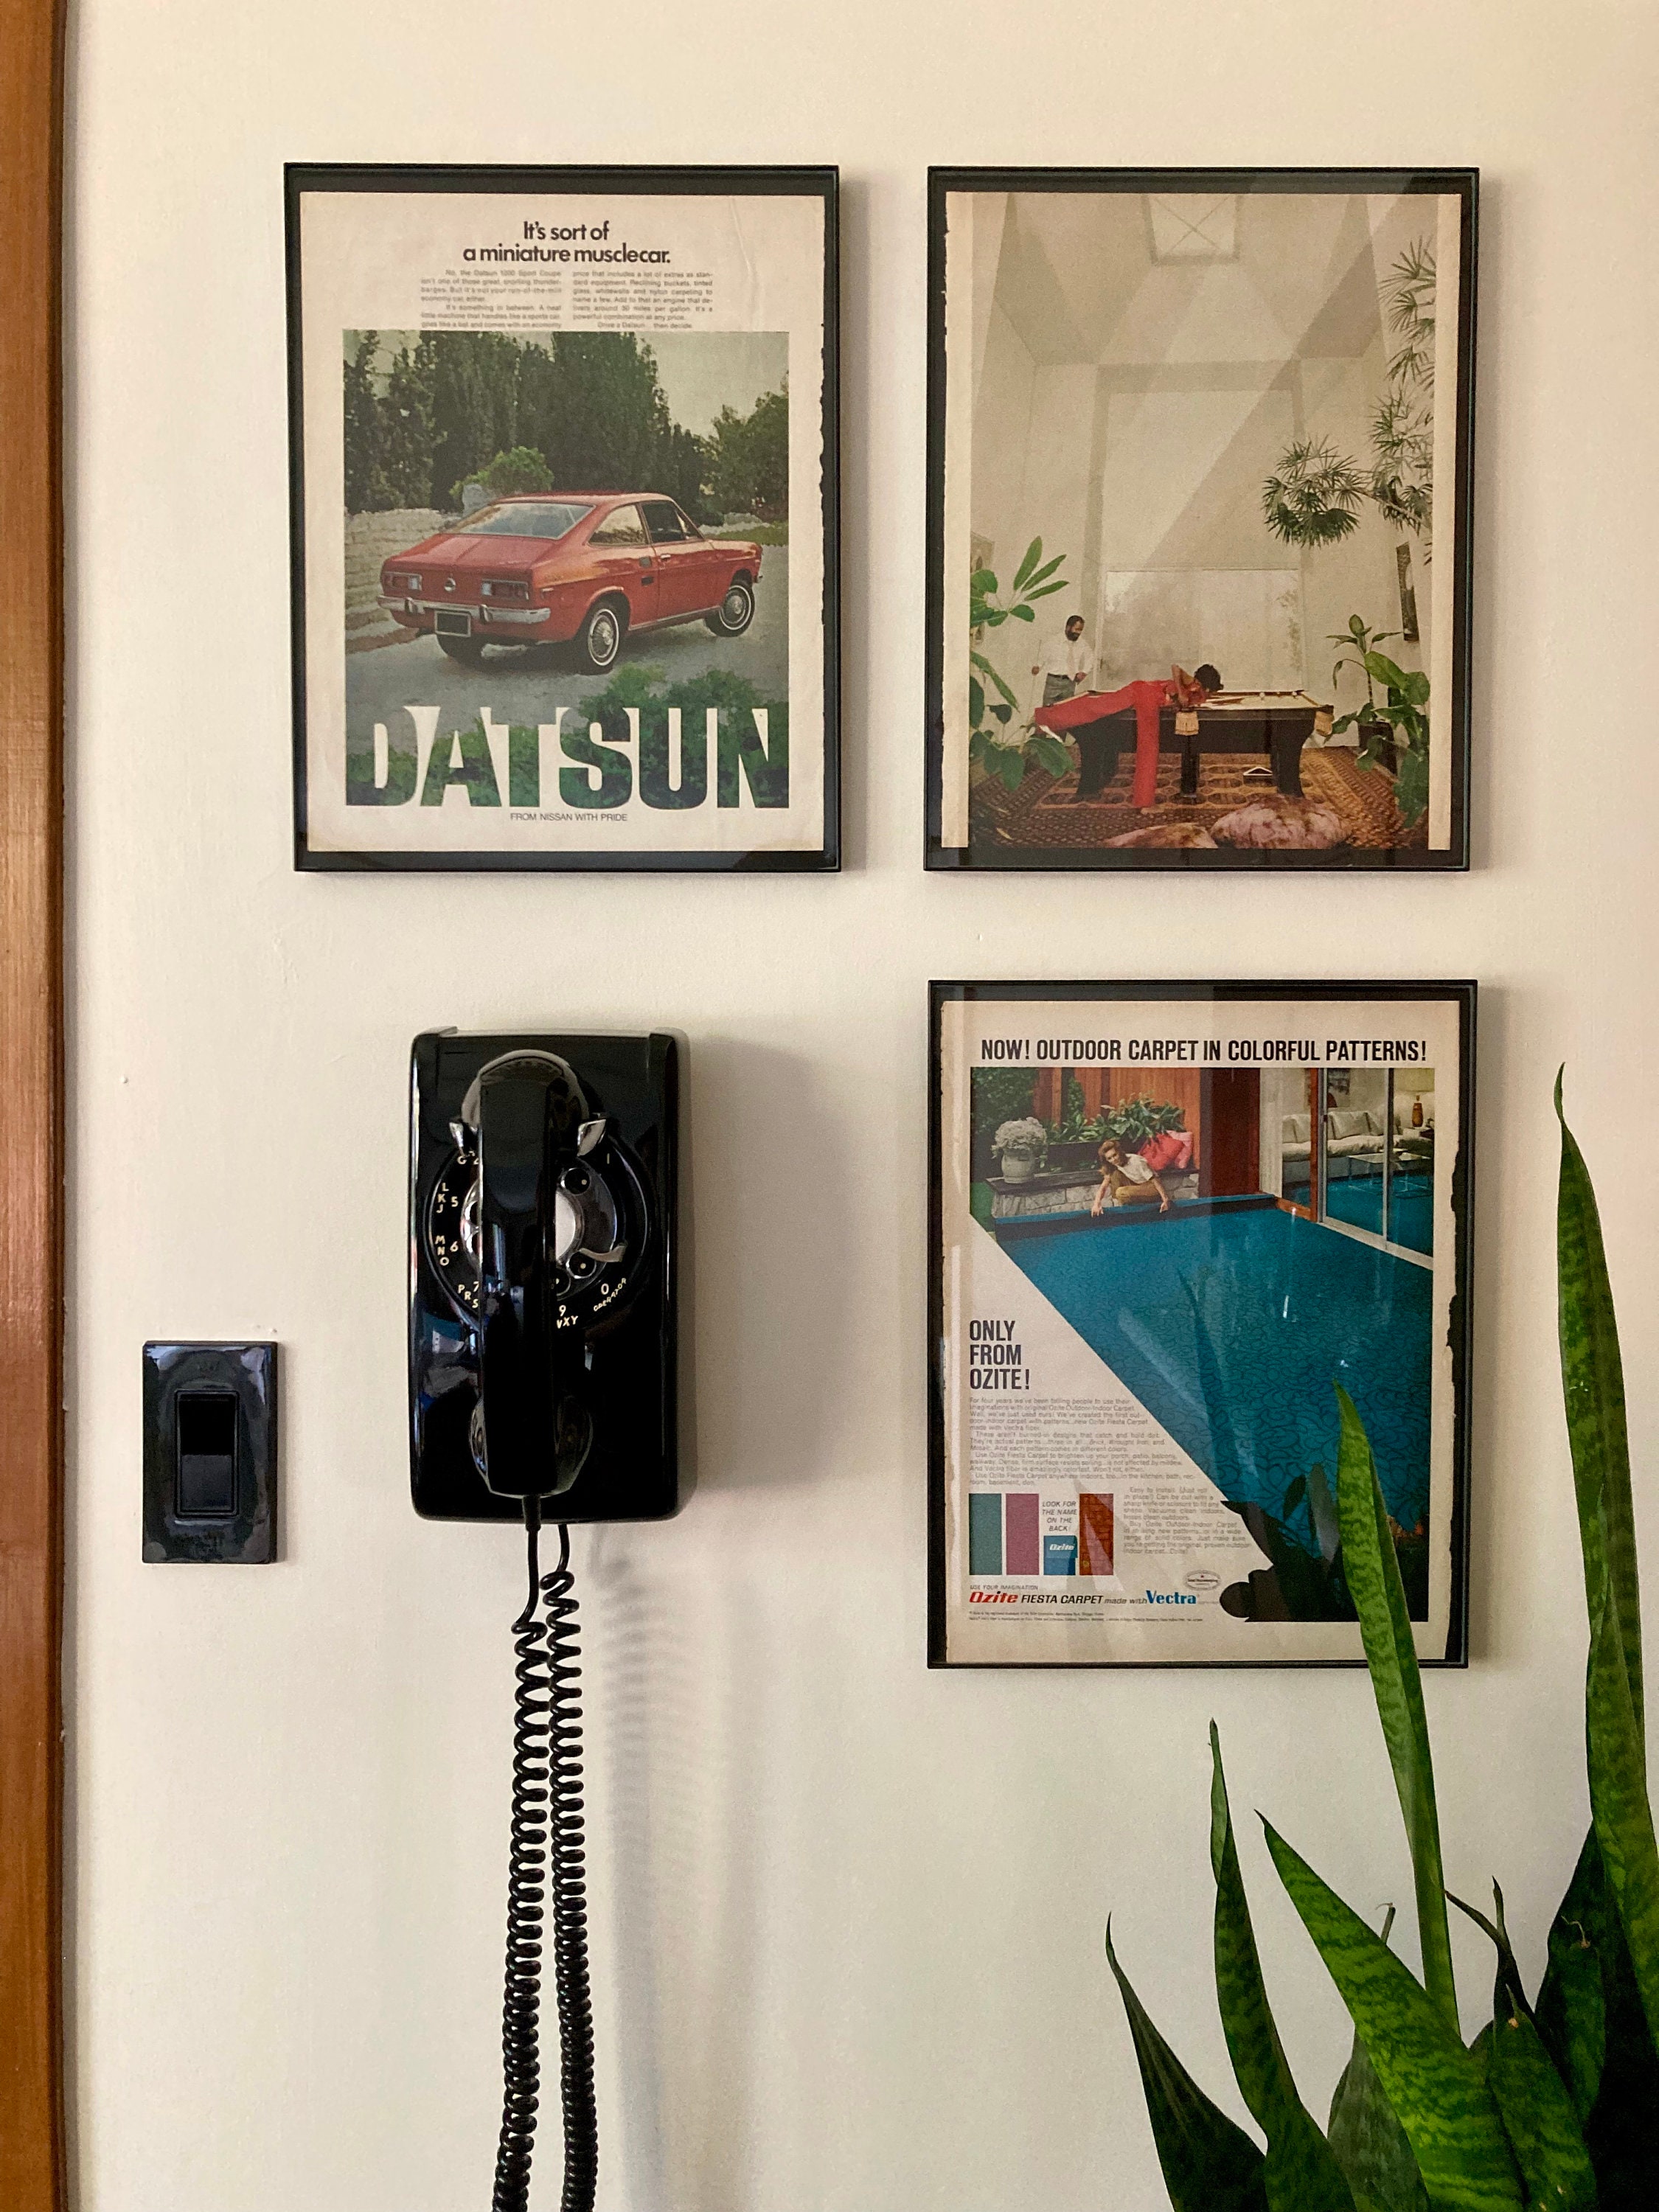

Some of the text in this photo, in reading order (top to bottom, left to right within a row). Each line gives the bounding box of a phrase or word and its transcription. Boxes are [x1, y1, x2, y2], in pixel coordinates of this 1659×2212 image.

[524, 220, 609, 240] It's sort of
[463, 243, 670, 263] a miniature musclecar.
[346, 706, 789, 808] DATSUN
[601, 813, 627, 821] PRIDE
[982, 1040, 1425, 1061] NOW! OUTDOOR CARPET IN COLORFUL PATTERNS!
[451, 1242, 458, 1252] 6
[559, 1305, 566, 1317] 9
[970, 1320, 1015, 1341] ONLY
[970, 1344, 1021, 1365] FROM
[970, 1368, 1029, 1390] OZITE!
[970, 1591, 1018, 1603] Ozite
[1021, 1595, 1057, 1603] FIESTA
[1061, 1596, 1103, 1604] CARPET
[1146, 1590, 1196, 1604] Vectra
